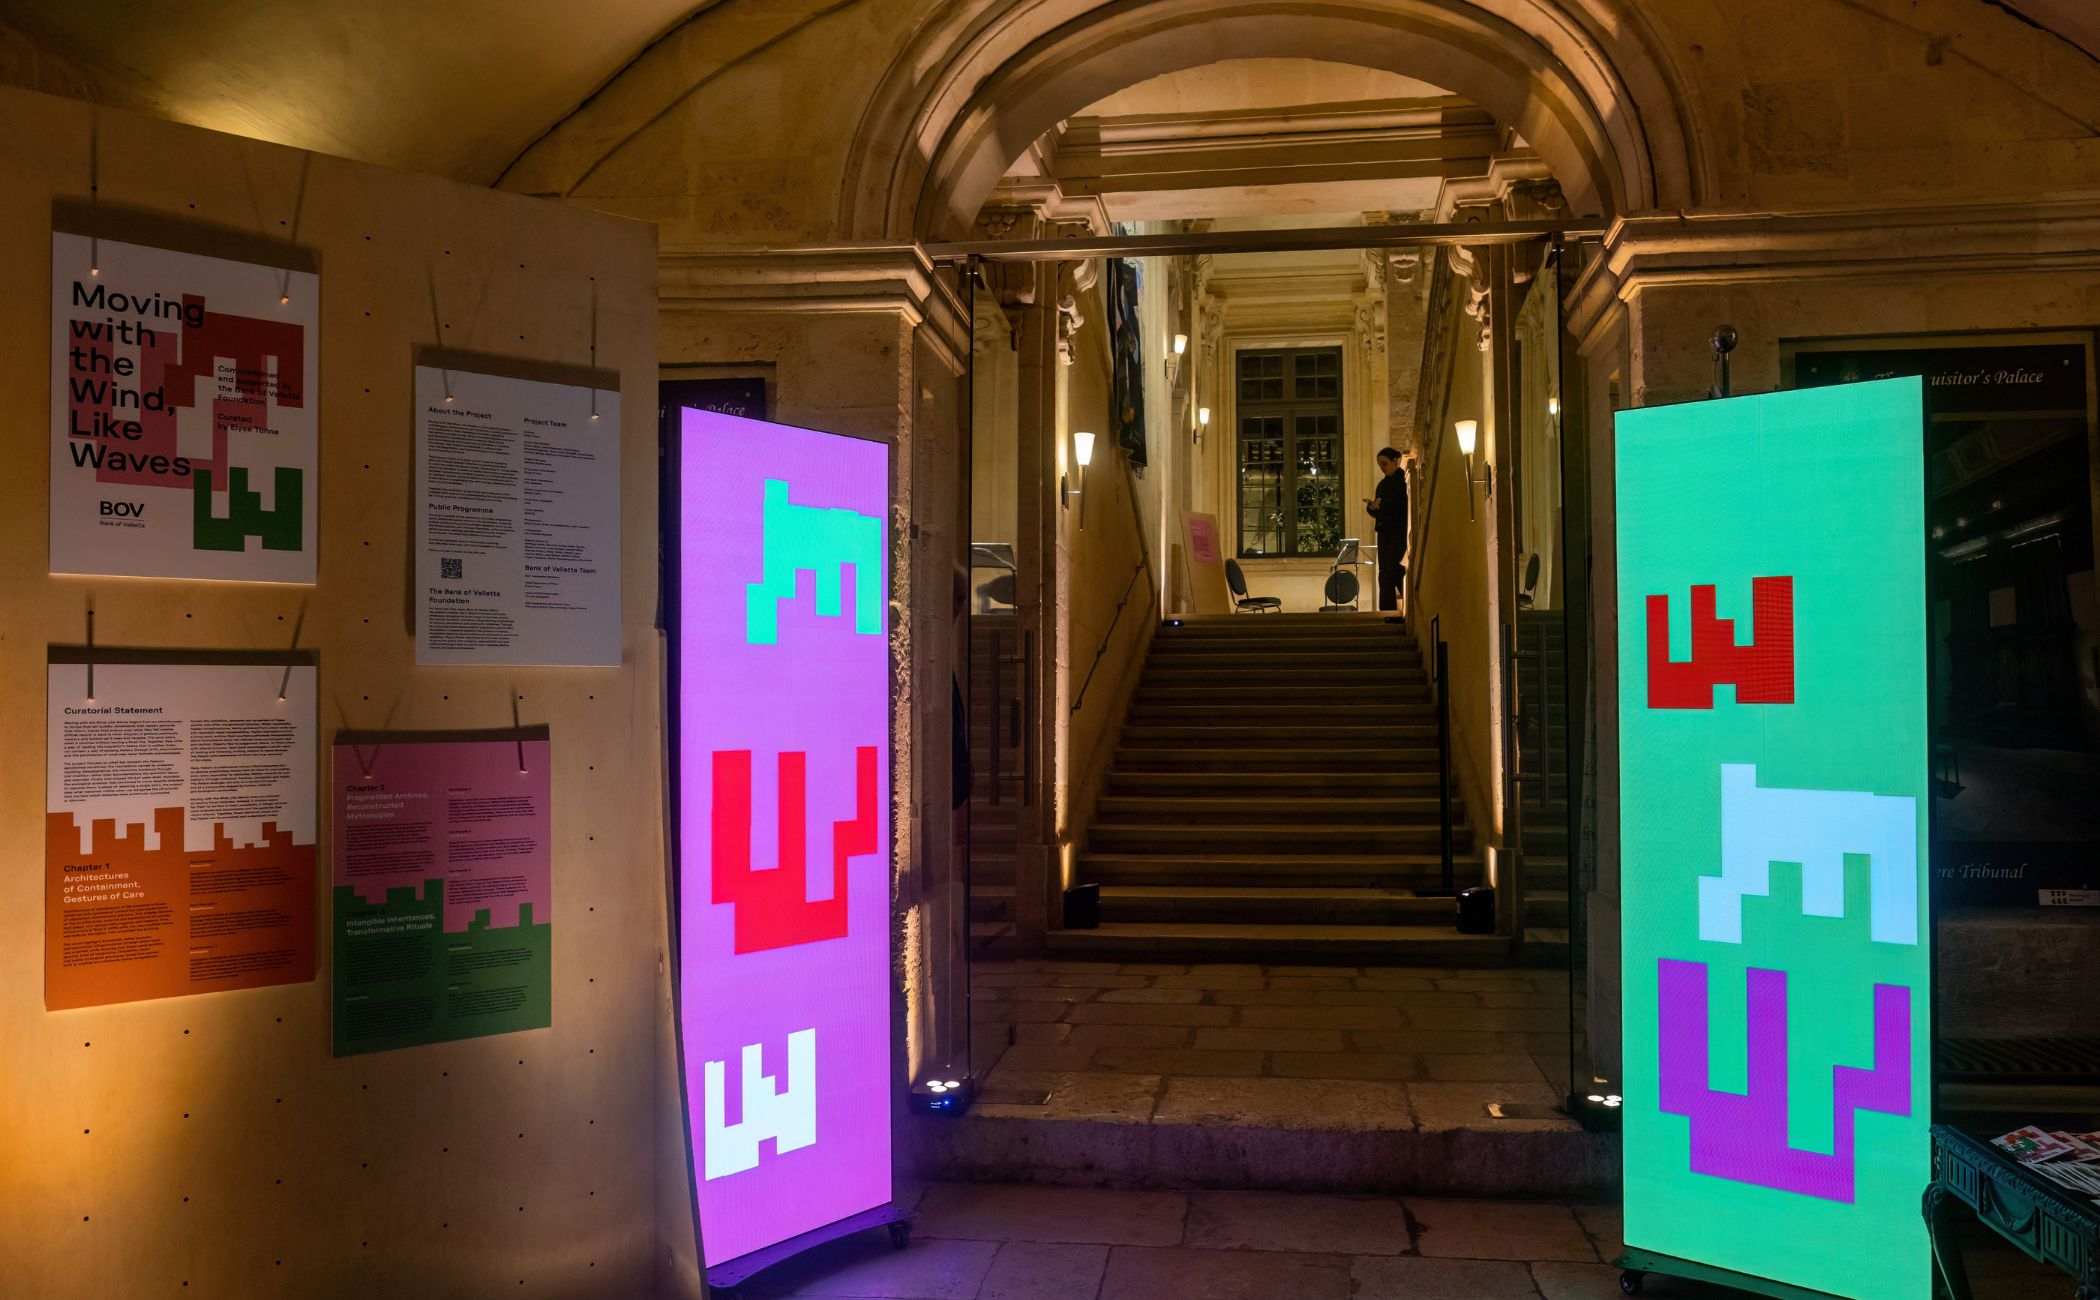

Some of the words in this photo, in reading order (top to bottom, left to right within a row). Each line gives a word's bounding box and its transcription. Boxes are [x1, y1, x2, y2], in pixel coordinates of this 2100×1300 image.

[73, 281, 205, 328] Moving
[70, 318, 156, 347] with
[70, 347, 134, 376] the
[1931, 369, 1990, 386] uisitor's
[1994, 368, 2044, 384] Palace
[70, 377, 175, 417] Wind,
[235, 386, 256, 395] Bank
[257, 389, 267, 397] of
[218, 394, 266, 406] Foundation
[217, 413, 253, 423] Curated
[428, 406, 451, 416] About
[452, 408, 465, 417] the
[466, 410, 492, 421] Project
[71, 410, 144, 441] Like
[217, 423, 228, 432] by
[230, 423, 253, 433] Elyse
[524, 417, 549, 427] Project
[550, 419, 568, 428] Team
[69, 442, 192, 477] Waves
[100, 501, 145, 517] BOV
[429, 503, 452, 512] Public
[453, 505, 494, 516] Programme
[525, 564, 542, 572] Bank
[543, 565, 551, 573] of
[552, 566, 579, 575] Valletta
[579, 567, 597, 575] Team
[429, 588, 443, 596] The
[444, 588, 462, 596] Bank
[463, 588, 472, 597] of
[473, 589, 501, 598] Valletta
[429, 597, 470, 606] Foundation
[64, 706, 113, 716] Curatorial
[114, 706, 164, 715] Statement
[64, 863, 104, 874] Chapter
[104, 862, 110, 871] 1
[1959, 862, 2028, 879] Tribunal
[64, 872, 130, 884] Architectures
[64, 885, 76, 895] of
[77, 880, 142, 893] Containment,
[64, 892, 109, 904] Gestures
[110, 891, 121, 901] of
[122, 890, 145, 901] Care
